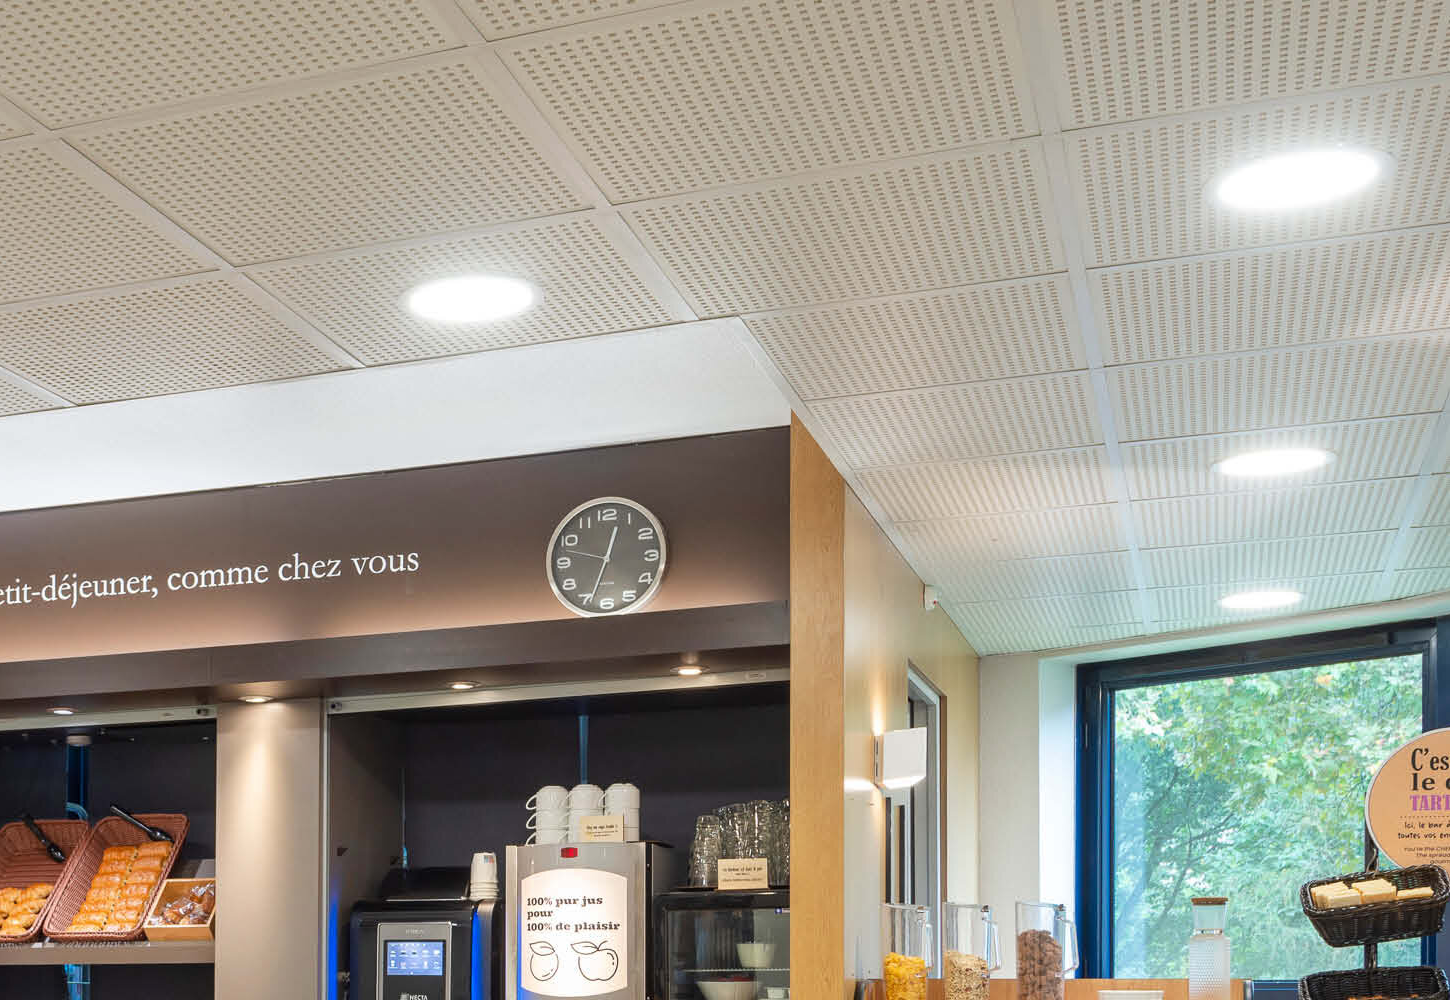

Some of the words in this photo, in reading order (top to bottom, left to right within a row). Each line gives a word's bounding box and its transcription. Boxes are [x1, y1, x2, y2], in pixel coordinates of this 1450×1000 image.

[597, 508, 618, 521] 12
[627, 512, 631, 525] 1
[579, 517, 591, 529] 11
[638, 528, 653, 540] 2
[561, 534, 578, 547] 10
[644, 549, 659, 562] 3
[557, 556, 571, 569] 9
[167, 564, 269, 591] comme
[278, 552, 342, 582] chez
[350, 552, 420, 576] vous
[637, 572, 653, 584] 4
[562, 578, 577, 591] 8
[578, 593, 593, 605] 7
[622, 590, 637, 602] 5
[599, 598, 615, 610] 6
[1411, 772, 1436, 792] le
[1418, 821, 1426, 829] le
[1428, 821, 1443, 829] bar
[1397, 832, 1421, 840] toutes
[526, 897, 553, 906] 100%
[555, 897, 579, 908] pur
[581, 895, 603, 908] jus
[526, 910, 553, 920] pour
[526, 922, 553, 932] 100%
[555, 922, 571, 931] de
[574, 921, 621, 933] plaisir
